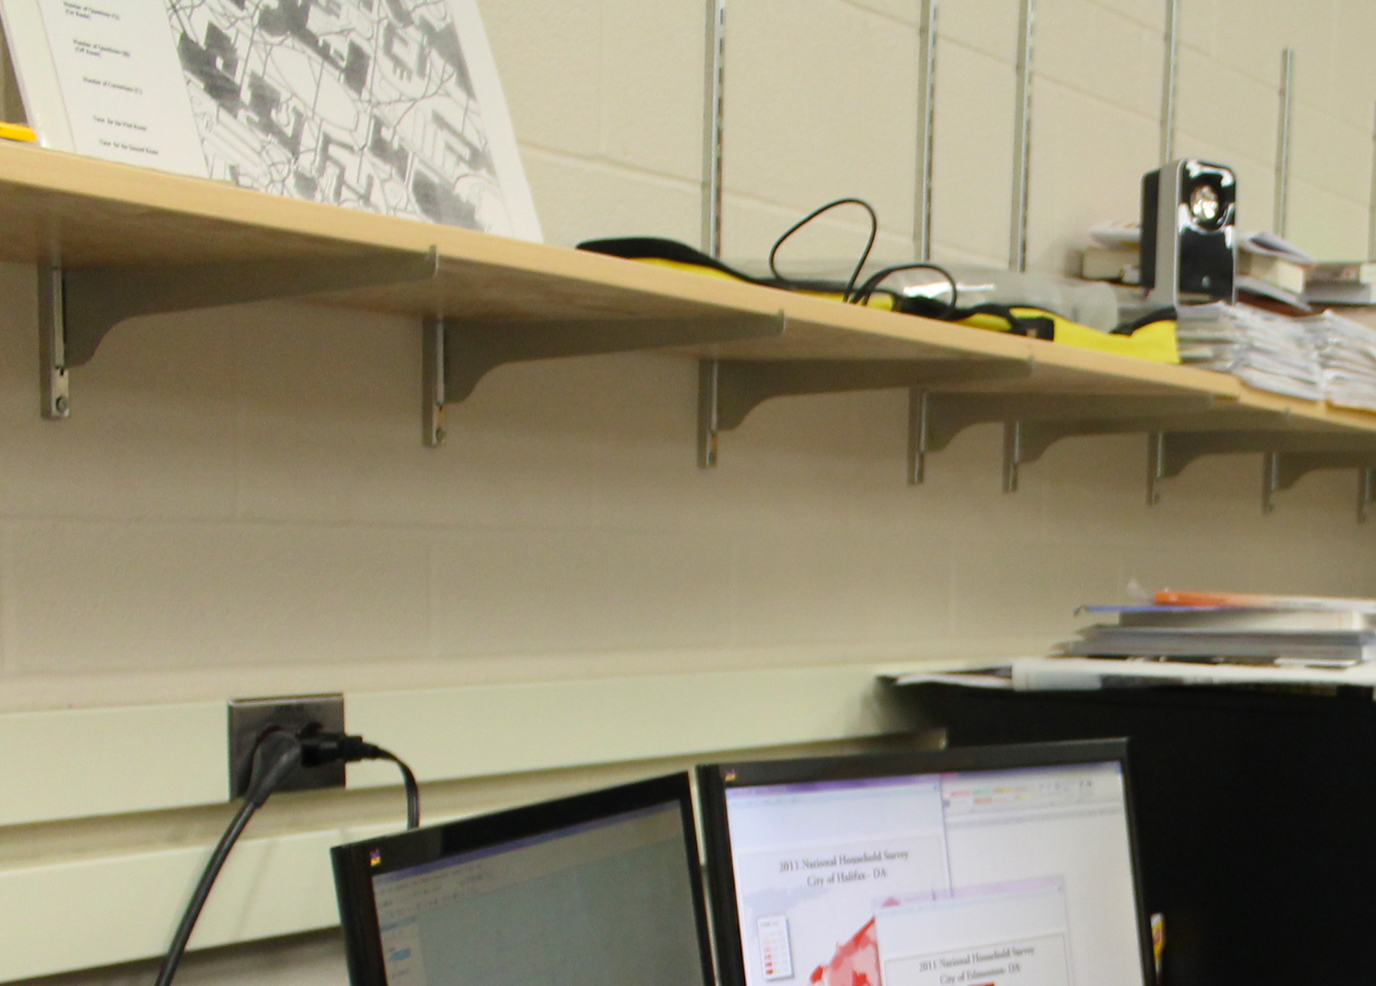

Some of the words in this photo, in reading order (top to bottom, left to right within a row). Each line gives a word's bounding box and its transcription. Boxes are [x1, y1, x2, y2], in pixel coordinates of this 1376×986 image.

[779, 860, 799, 872] 2011
[801, 856, 837, 869] National
[838, 850, 882, 865] Household
[883, 849, 909, 861] Survey
[806, 874, 824, 887] City
[826, 872, 835, 883] of
[836, 870, 866, 883] Halifax
[919, 961, 937, 972] 2011
[939, 955, 971, 969] National
[972, 948, 1011, 962] Household
[1012, 946, 1035, 957] Survey
